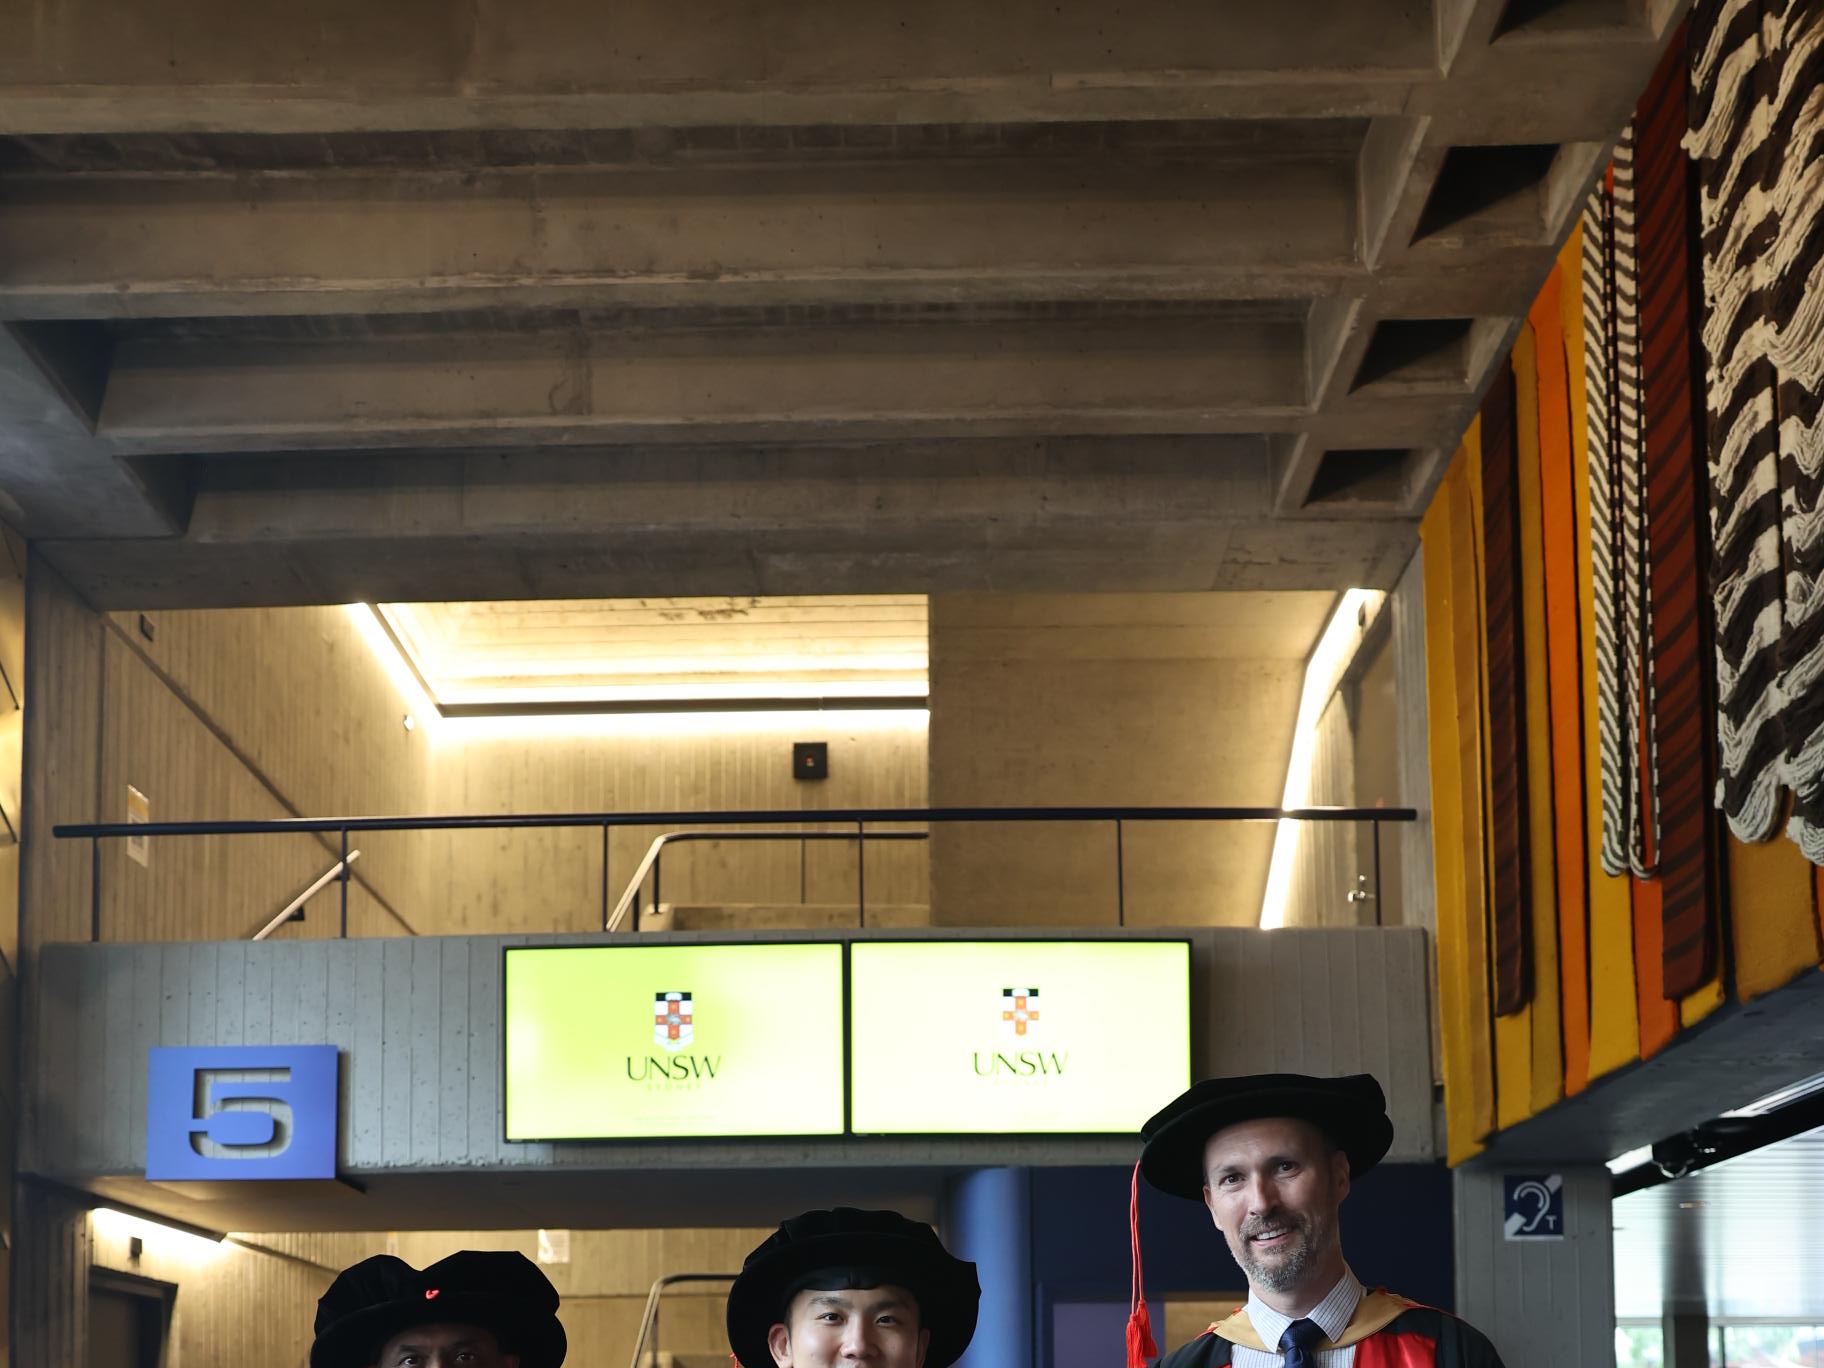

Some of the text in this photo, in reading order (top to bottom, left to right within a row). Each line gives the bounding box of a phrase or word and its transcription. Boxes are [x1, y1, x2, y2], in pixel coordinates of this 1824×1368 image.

[627, 1056, 721, 1081] UNSW
[974, 1052, 1069, 1076] UNSW
[189, 1067, 293, 1159] 5
[1545, 1215, 1557, 1230] T
